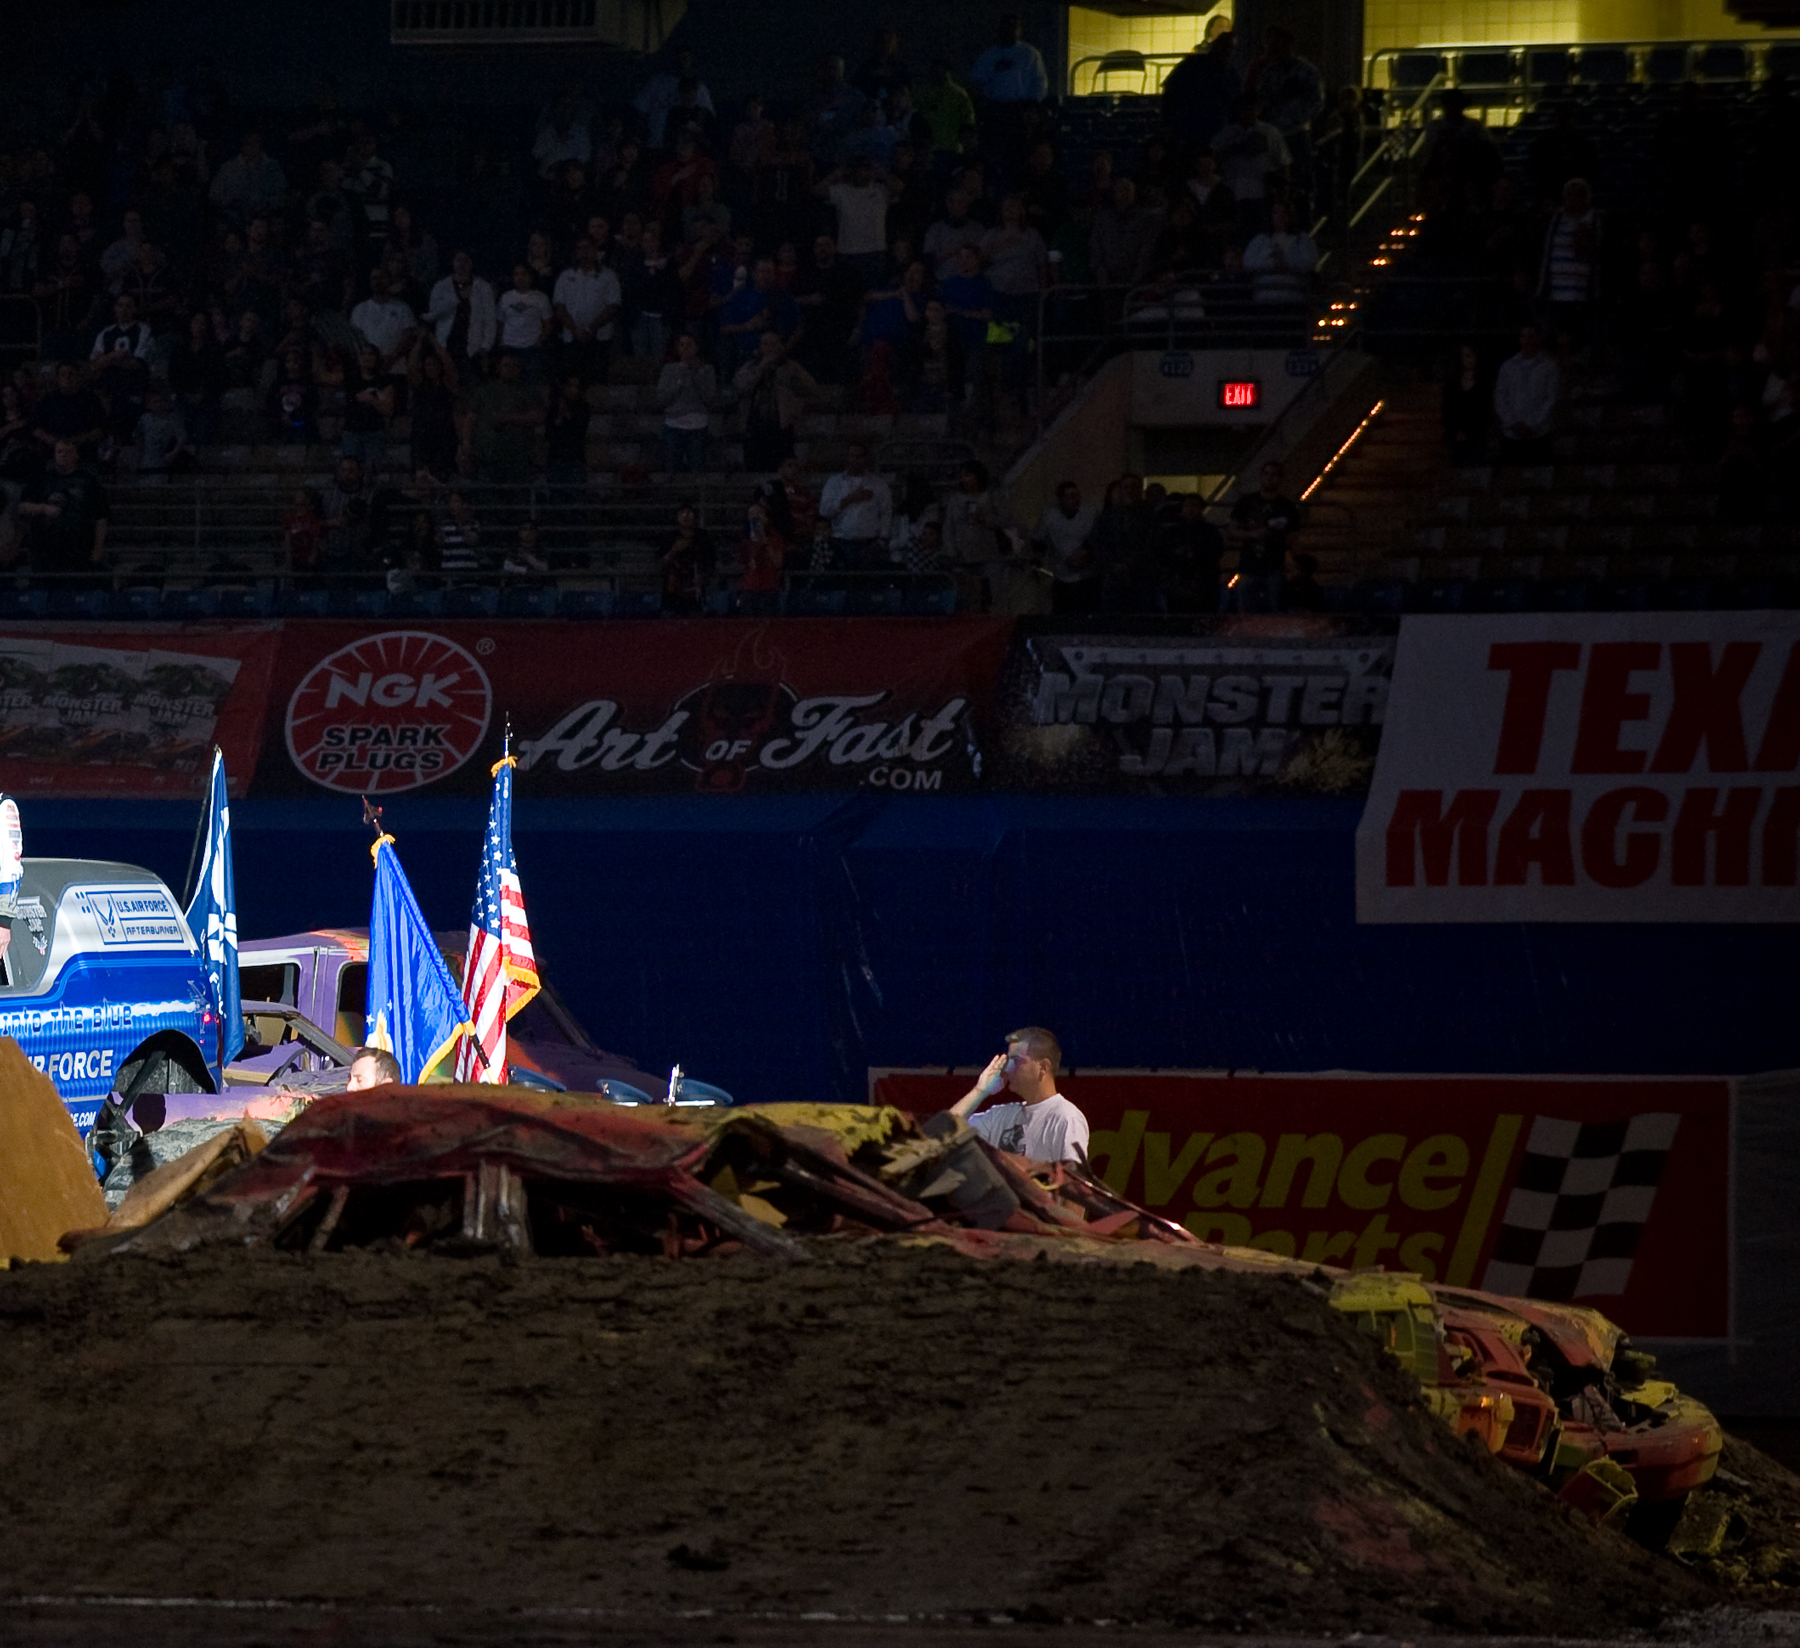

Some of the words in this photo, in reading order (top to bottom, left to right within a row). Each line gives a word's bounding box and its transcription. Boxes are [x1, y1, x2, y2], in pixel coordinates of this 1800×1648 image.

[1225, 384, 1254, 405] EXIT
[325, 672, 457, 708] NGK
[1034, 671, 1388, 725] MONSTER
[323, 724, 450, 747] SPARK
[516, 699, 691, 772] Art
[705, 739, 749, 762] OF
[759, 690, 969, 771] Fast
[317, 747, 444, 773] PLUGS
[1120, 727, 1289, 776] JAM
[858, 762, 943, 791] .COM
[116, 900, 132, 912] U.S.
[131, 900, 144, 912] AIR
[143, 900, 168, 912] FORCE
[126, 926, 179, 936] AFTERBURNER
[48, 1050, 114, 1081] FORCE
[1088, 1109, 1471, 1212] dvance
